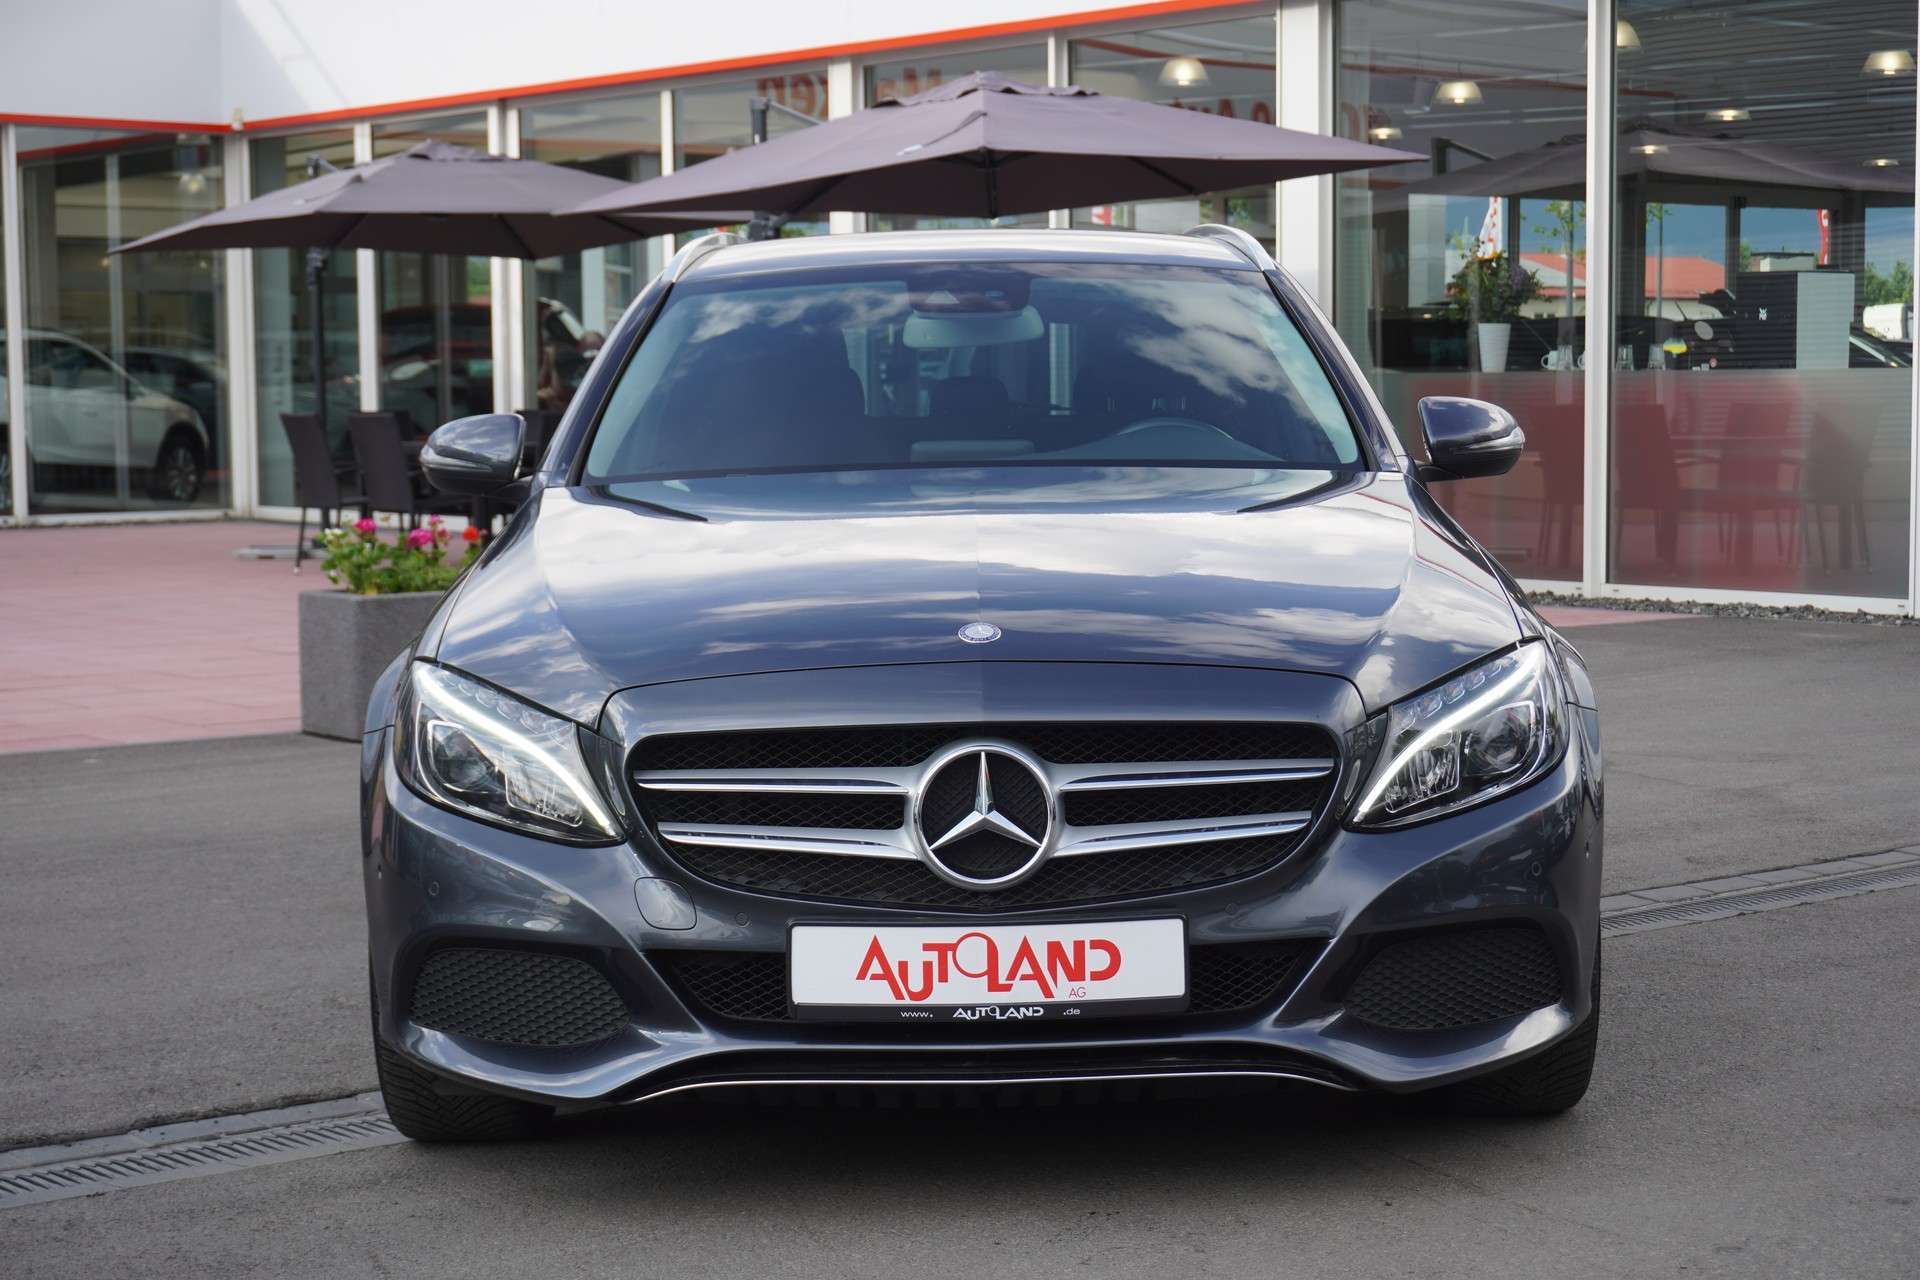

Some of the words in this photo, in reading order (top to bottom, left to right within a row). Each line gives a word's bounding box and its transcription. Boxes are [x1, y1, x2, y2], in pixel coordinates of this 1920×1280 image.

[1069, 987, 1086, 998] AG
[901, 1010, 933, 1018] www.
[1063, 1007, 1080, 1016] .de
